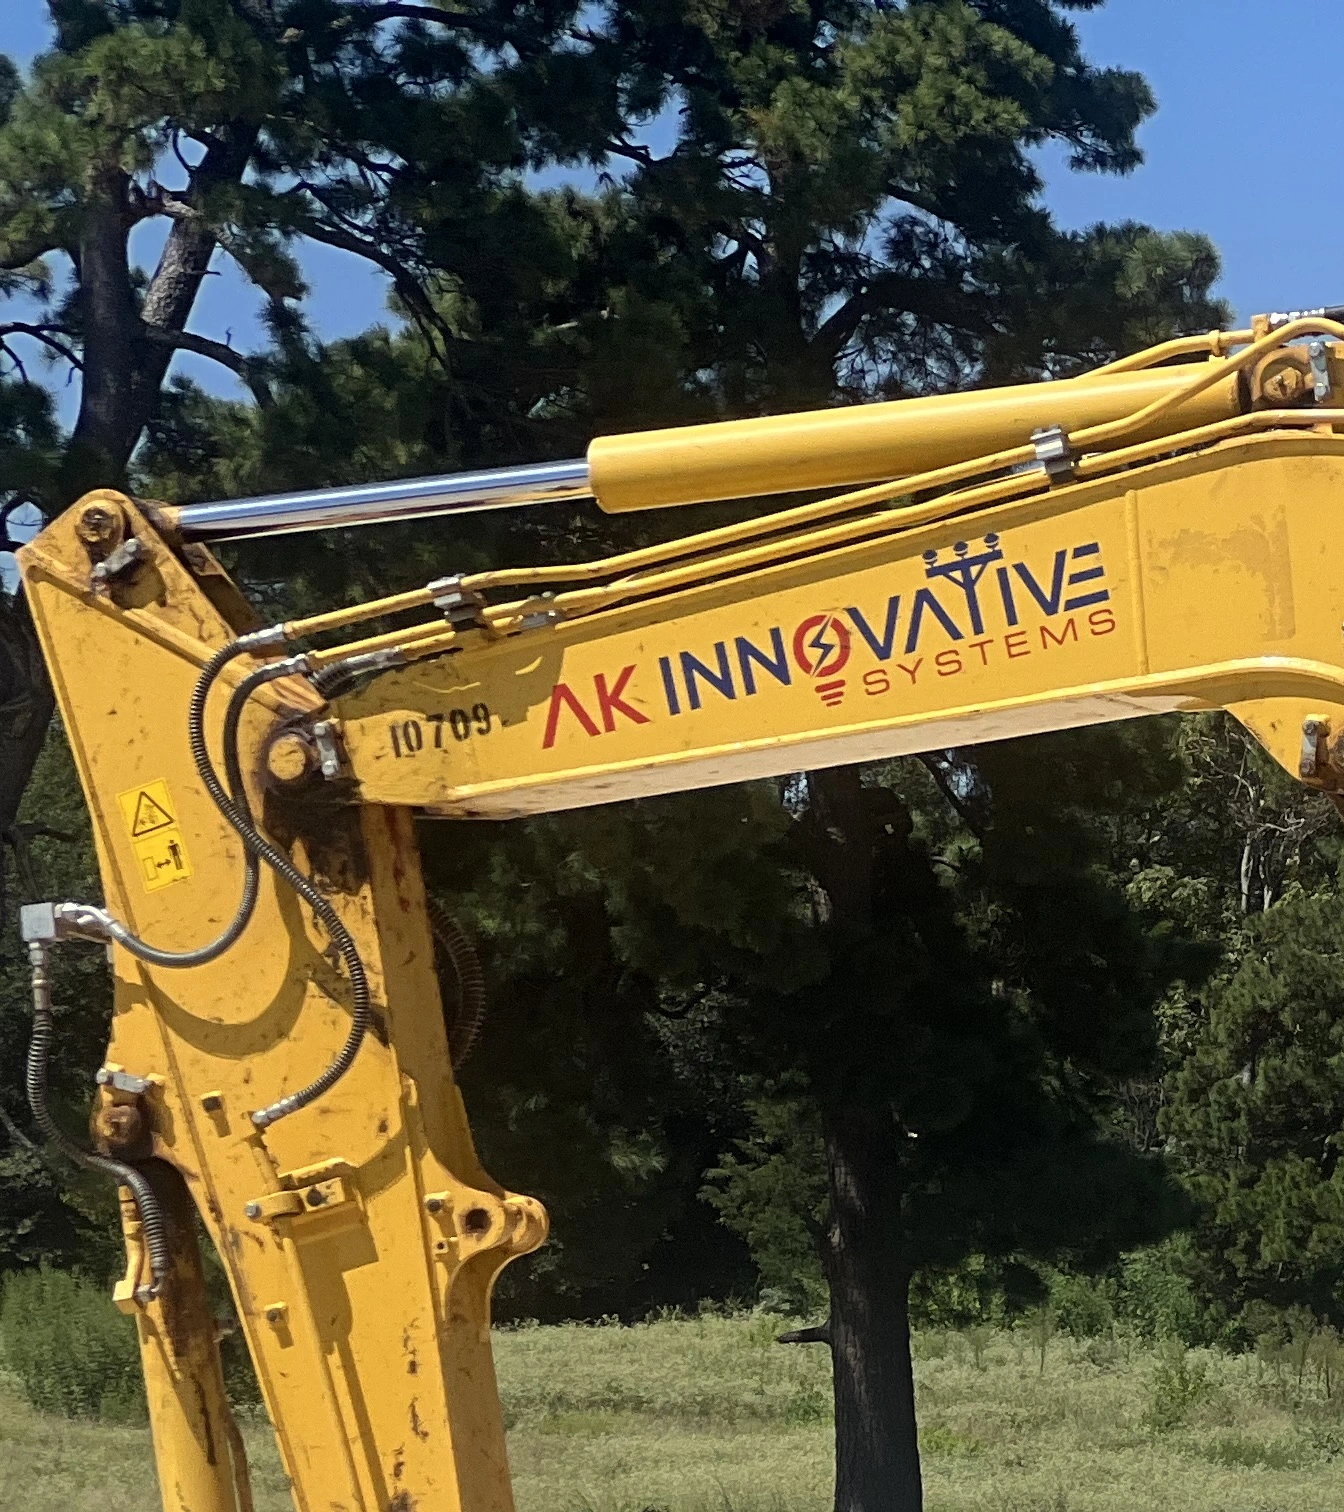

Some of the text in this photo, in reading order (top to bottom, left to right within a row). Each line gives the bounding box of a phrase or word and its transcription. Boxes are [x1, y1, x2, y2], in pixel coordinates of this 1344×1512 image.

[542, 533, 1110, 749] AK INNOVATIVE
[862, 608, 1116, 696] SYSTEMS
[390, 703, 491, 758] 10709
